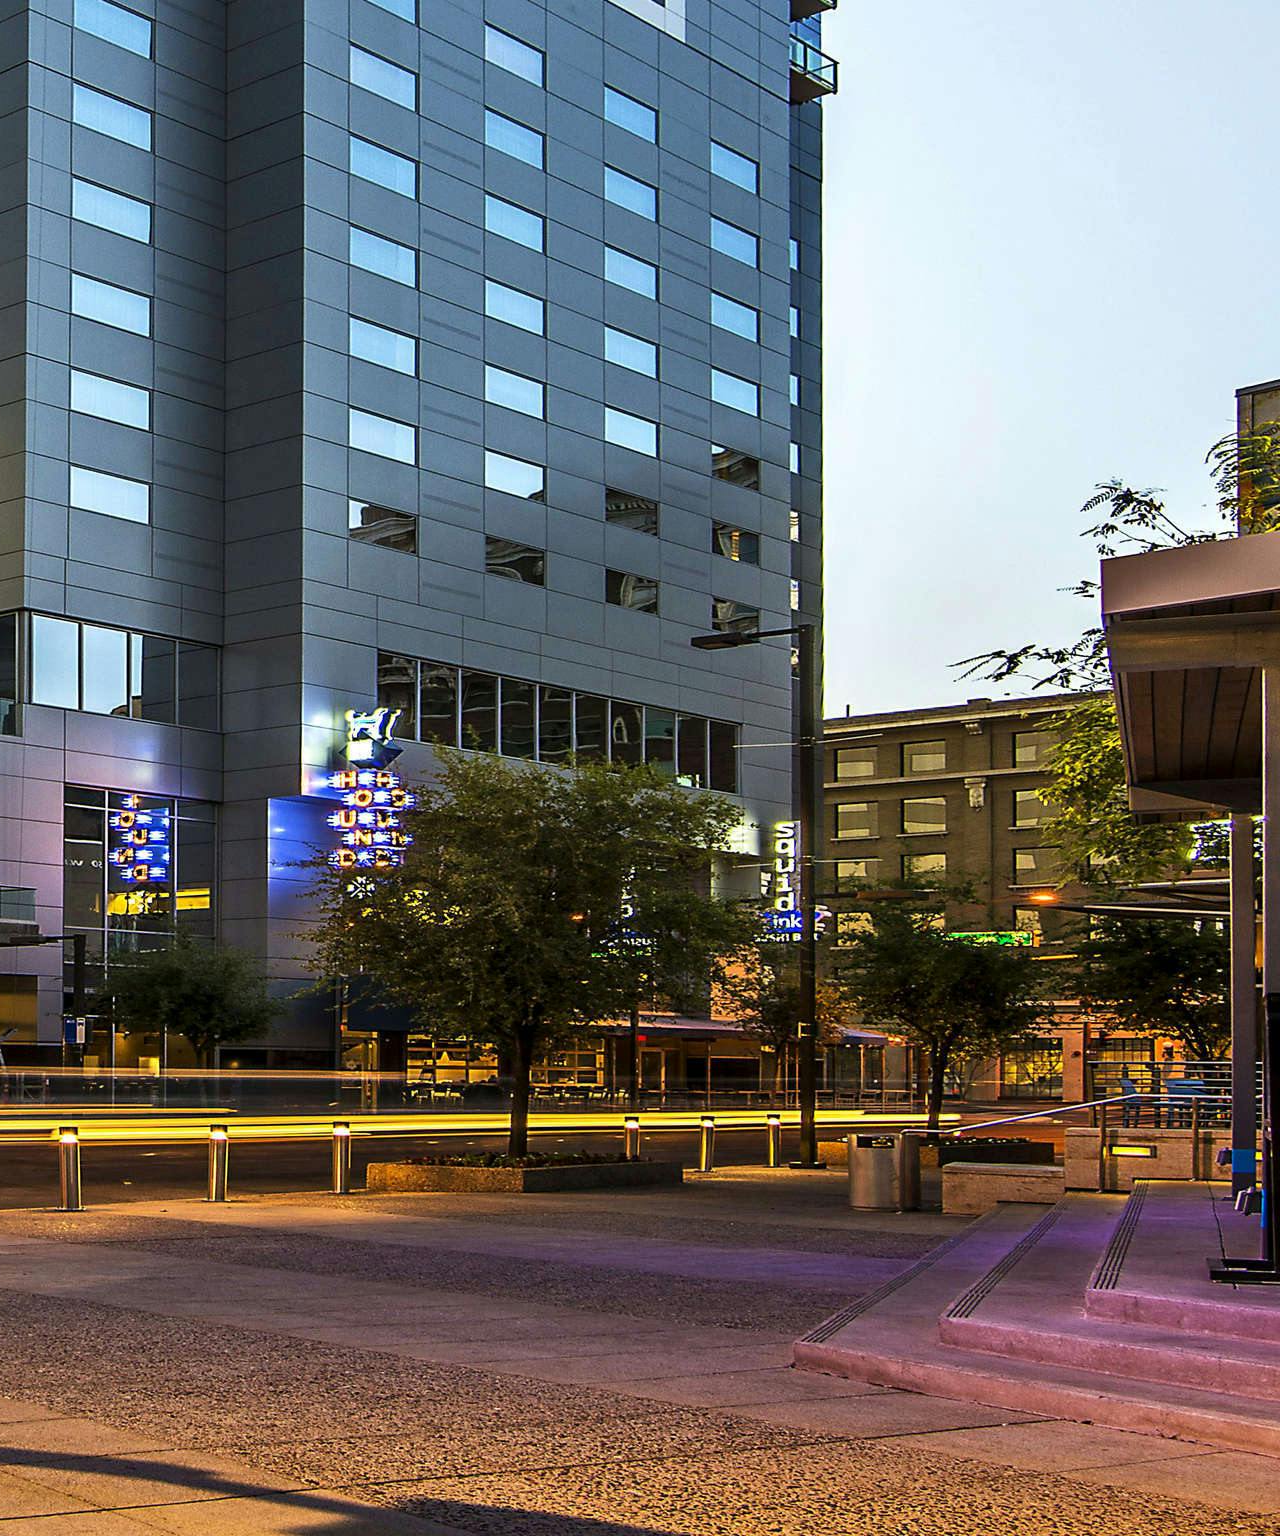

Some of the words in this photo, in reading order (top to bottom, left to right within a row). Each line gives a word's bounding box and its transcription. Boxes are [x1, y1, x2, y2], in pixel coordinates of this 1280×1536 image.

[338, 771, 374, 868] HOUND
[774, 821, 797, 911] squid
[773, 914, 803, 928] ink
